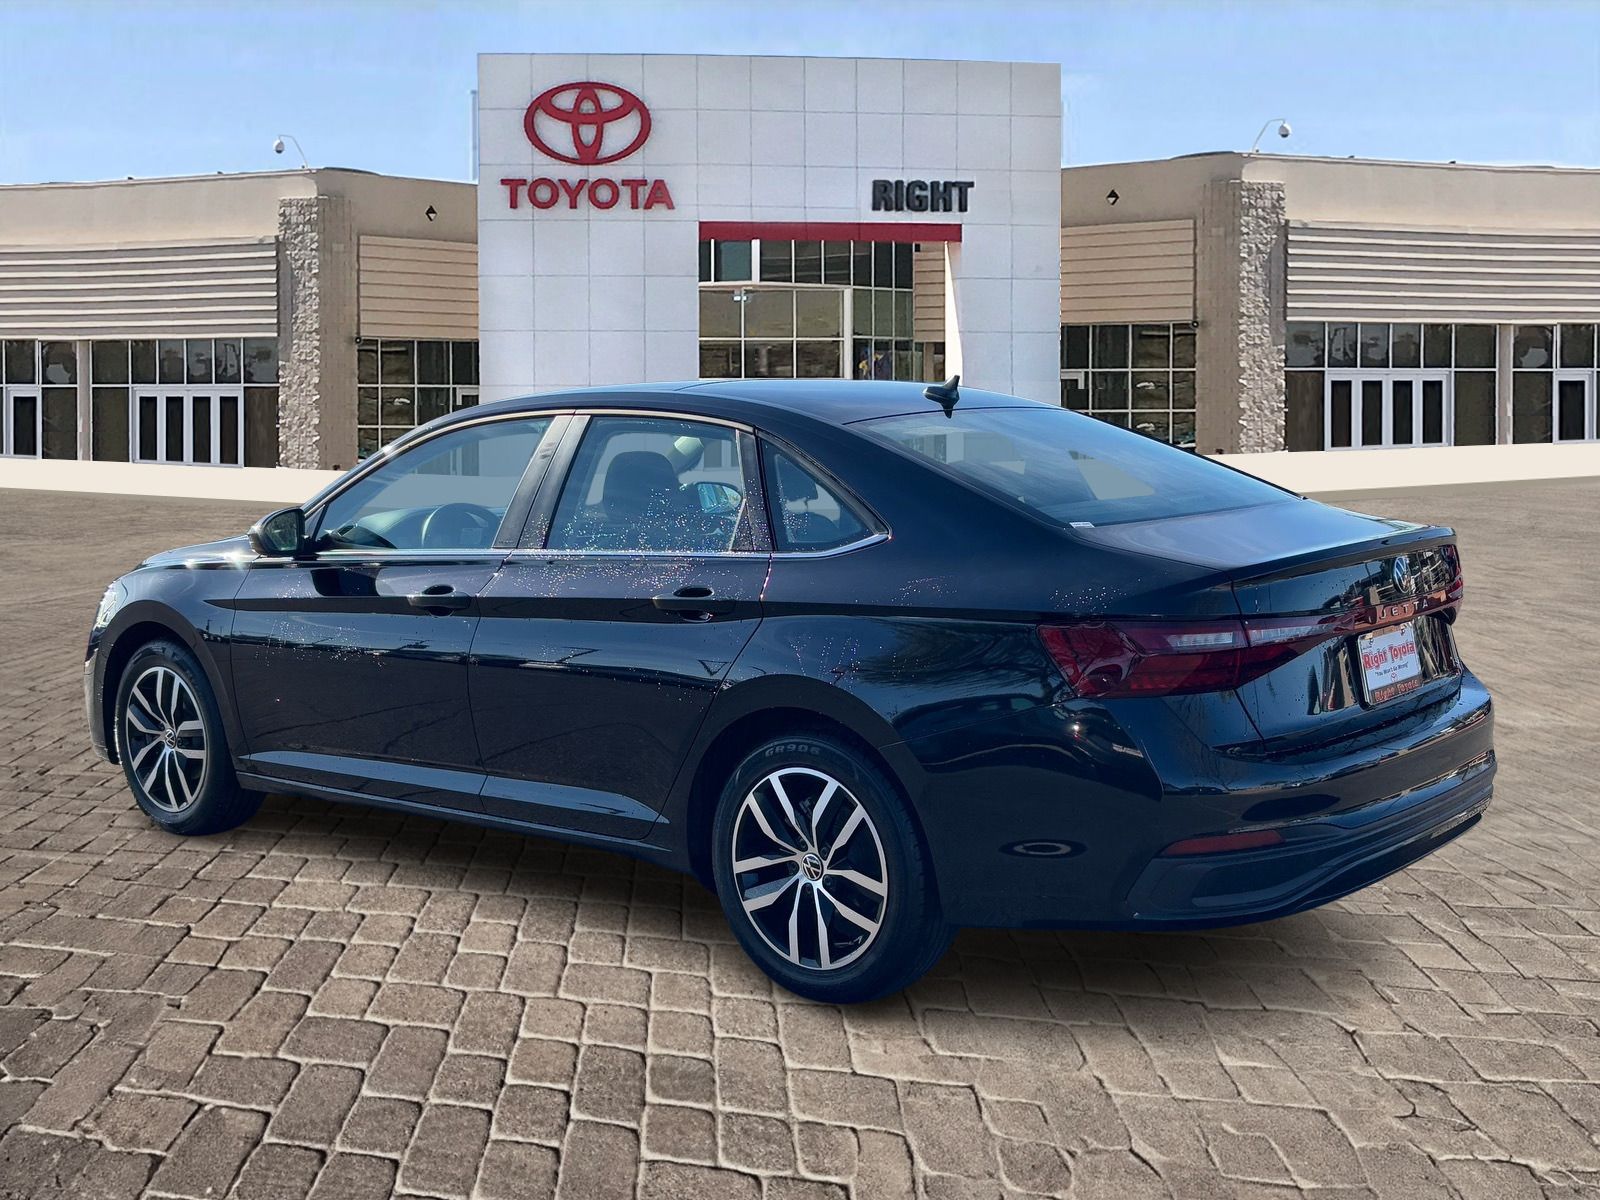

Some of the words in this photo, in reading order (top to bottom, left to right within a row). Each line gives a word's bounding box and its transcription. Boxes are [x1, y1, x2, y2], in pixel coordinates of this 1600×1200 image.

[500, 177, 675, 209] TOYOTA
[872, 179, 974, 212] RIGHT
[1381, 599, 1429, 619] JETTA
[1363, 650, 1387, 669] Right
[1389, 642, 1415, 661] Toyota
[1375, 687, 1395, 701] Right
[1397, 680, 1419, 694] Toyota
